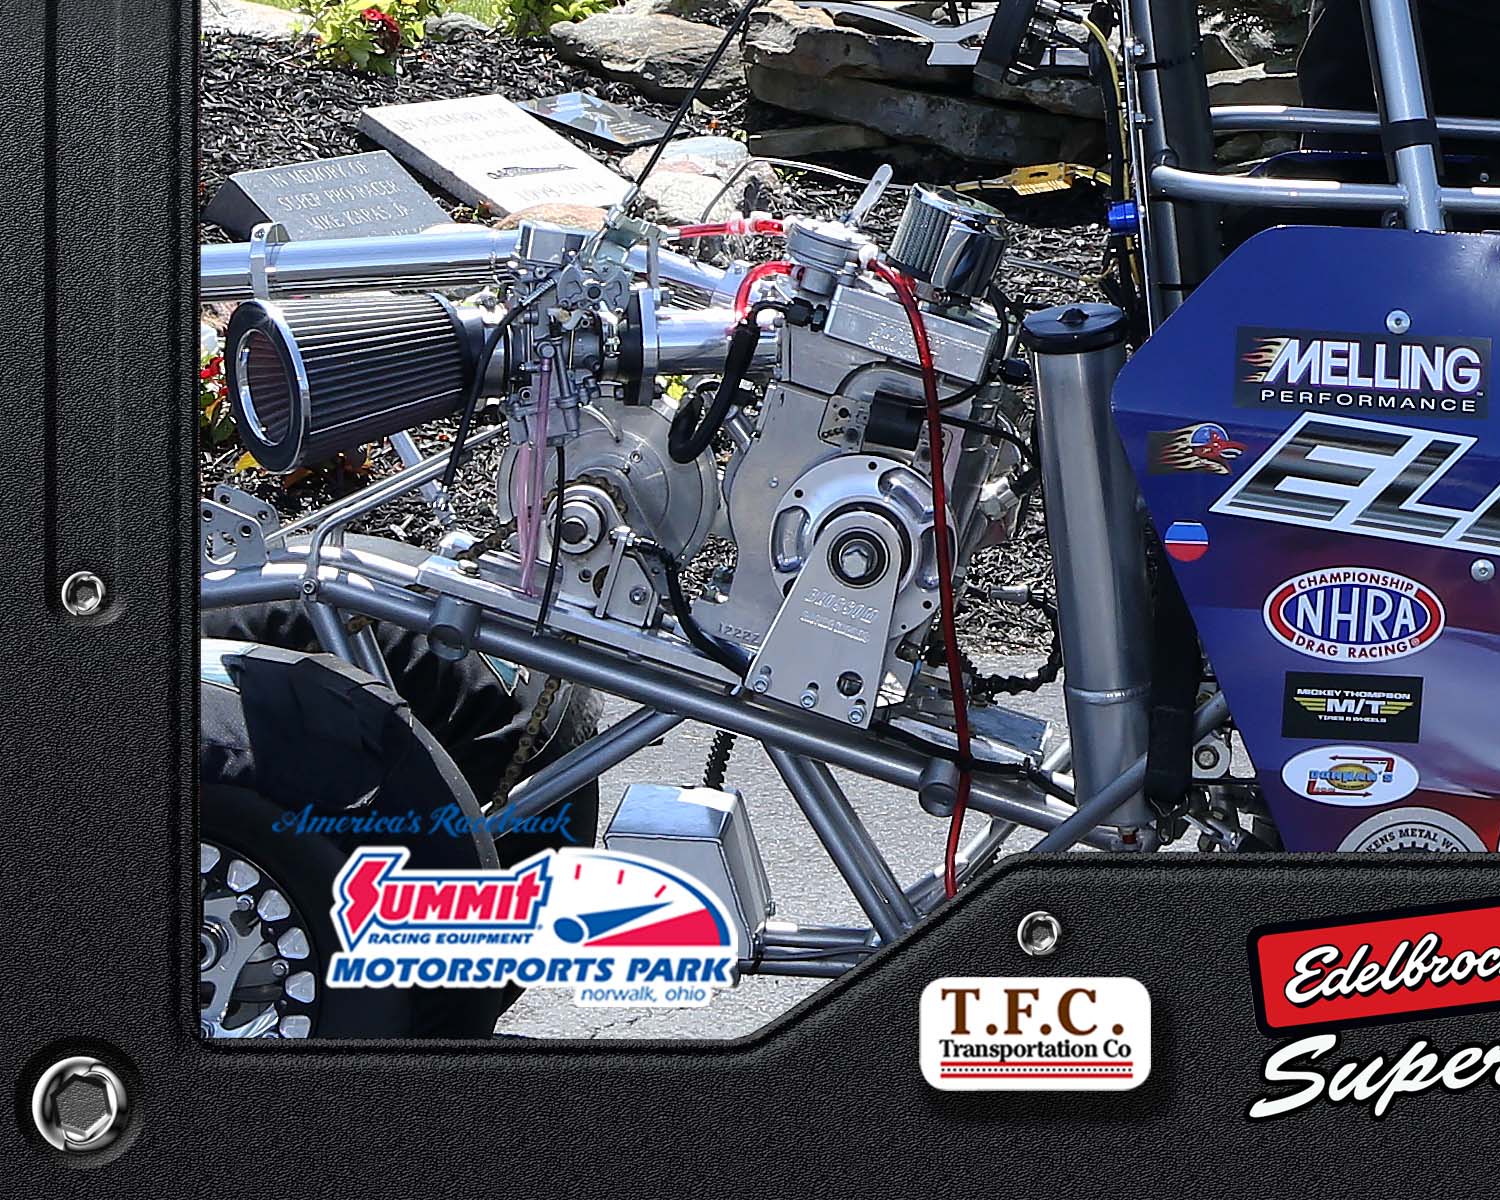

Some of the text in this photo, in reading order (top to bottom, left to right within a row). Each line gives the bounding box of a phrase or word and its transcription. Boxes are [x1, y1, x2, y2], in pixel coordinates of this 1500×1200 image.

[268, 160, 369, 188] IN MEMORY OF
[277, 180, 401, 212] SUPER PRO RACER
[306, 213, 345, 230] MIKE
[1263, 338, 1481, 393] MELLING
[1261, 390, 1477, 413] PERFORMANCE
[1298, 571, 1415, 593] CHAMPIONSHIP
[1296, 587, 1417, 642] NHRA
[1295, 635, 1408, 659] DRAG RACING
[1296, 688, 1411, 700] MICKEY THOMPSON
[1326, 698, 1386, 715] M/T
[1363, 827, 1460, 853] KENS METAL WO
